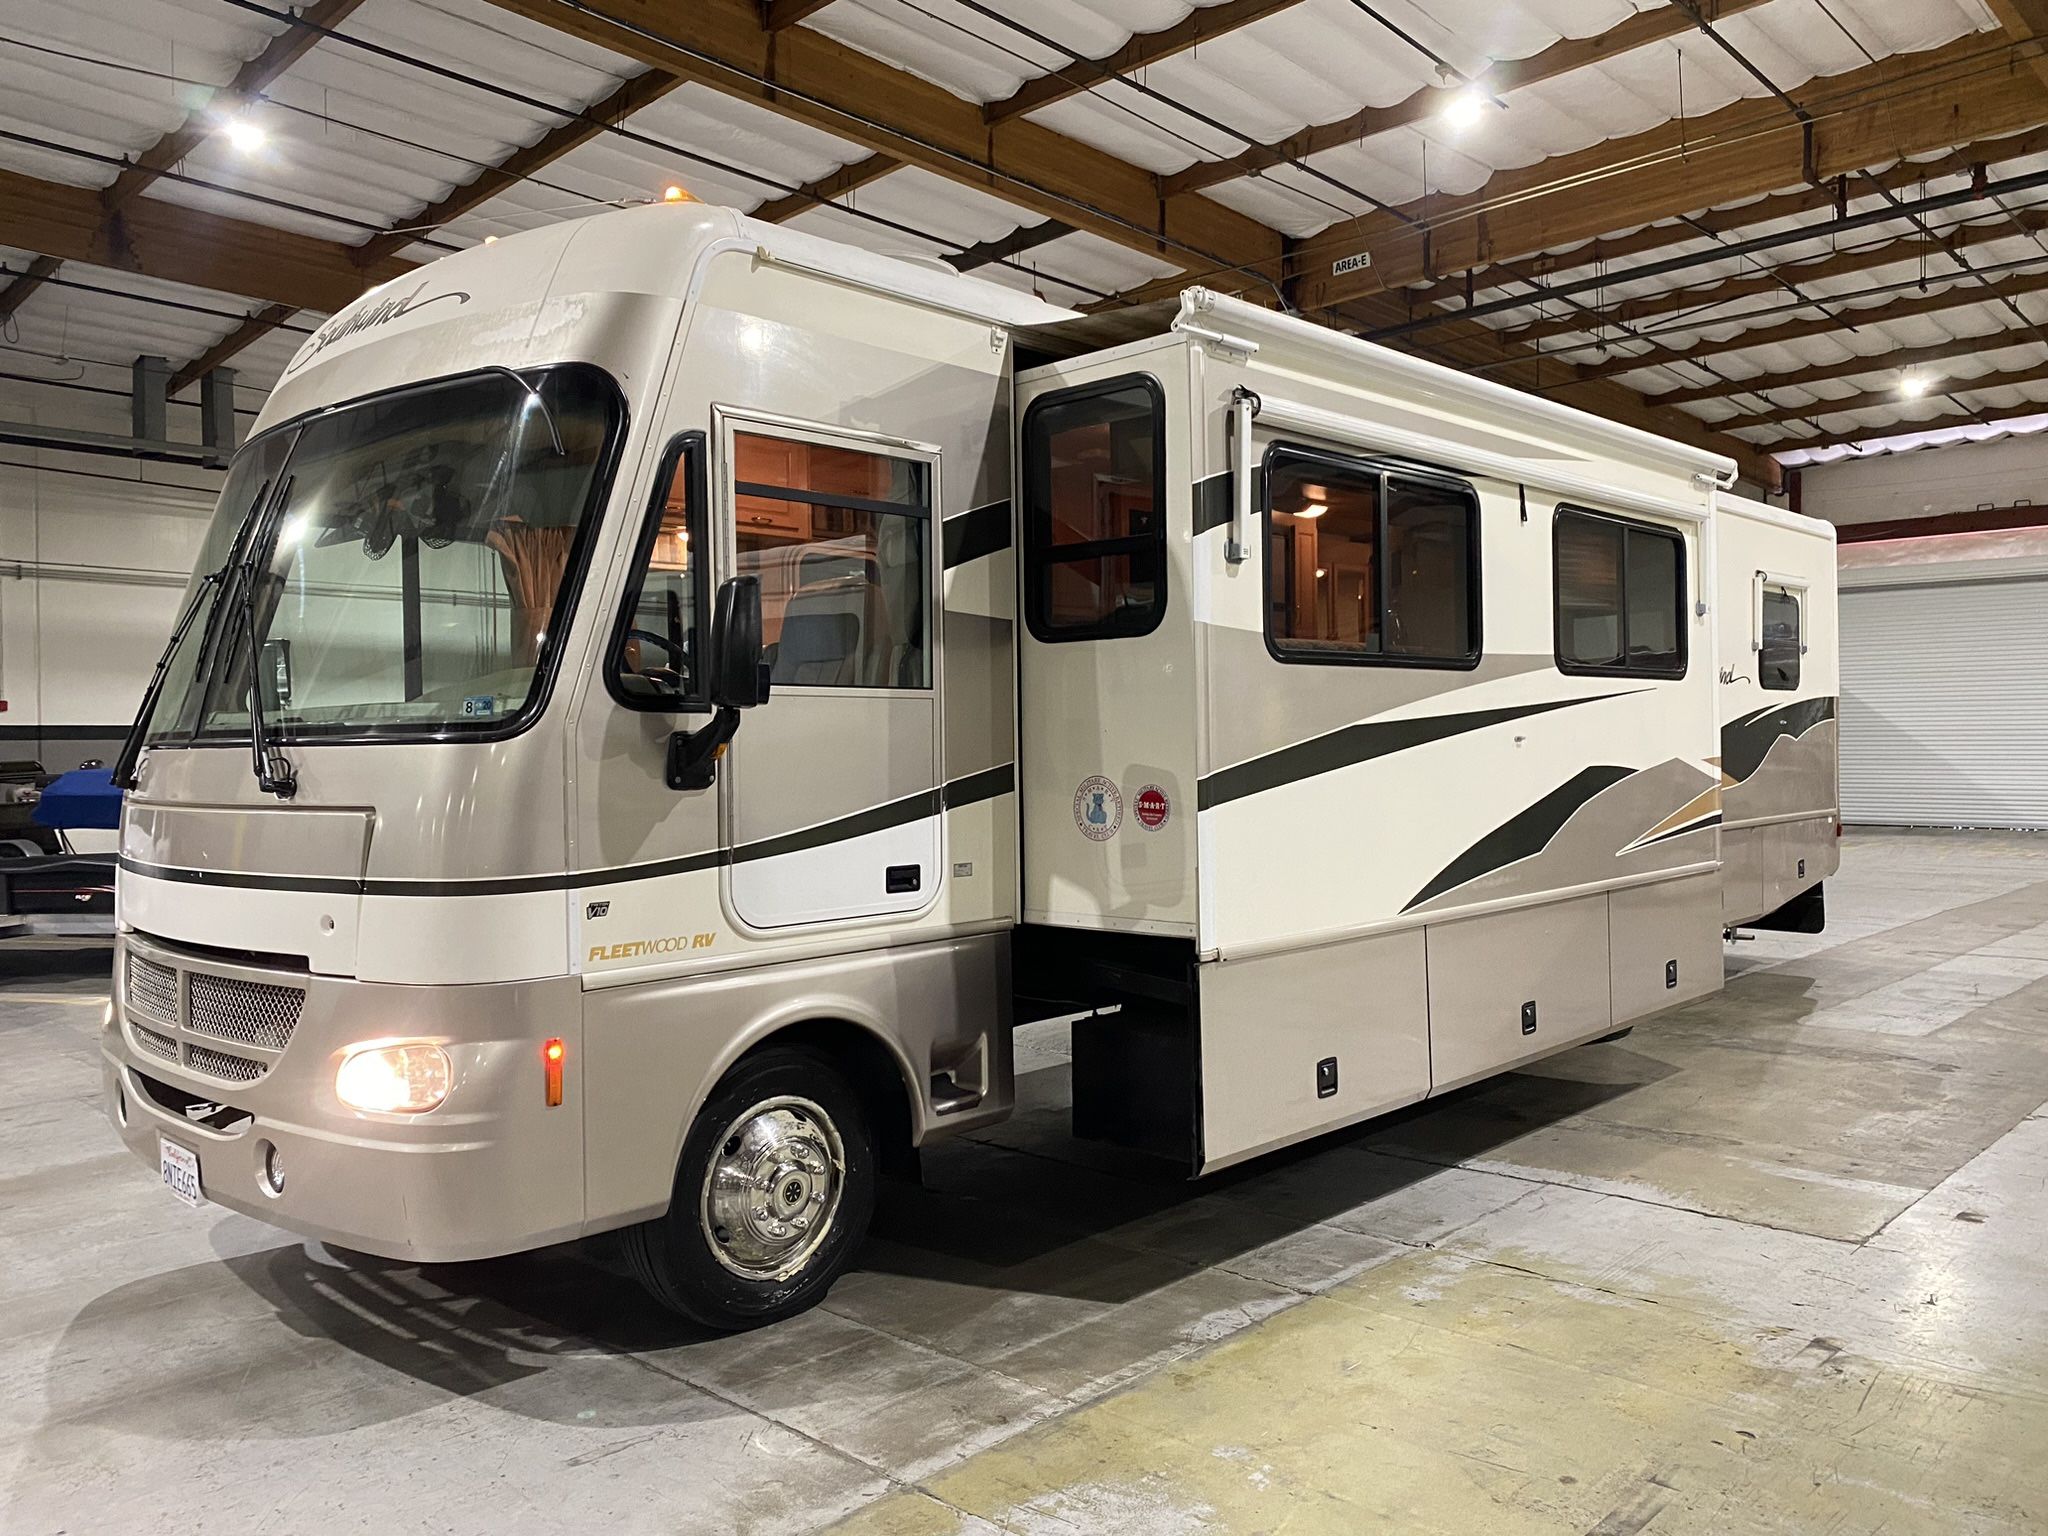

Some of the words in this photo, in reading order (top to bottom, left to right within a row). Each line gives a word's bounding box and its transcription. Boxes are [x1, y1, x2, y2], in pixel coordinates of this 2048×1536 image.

[1335, 255, 1367, 273] AREA-E
[465, 702, 473, 713] 8
[588, 906, 607, 918] V10
[588, 936, 688, 961] FLEETWOOD
[692, 932, 717, 949] RV
